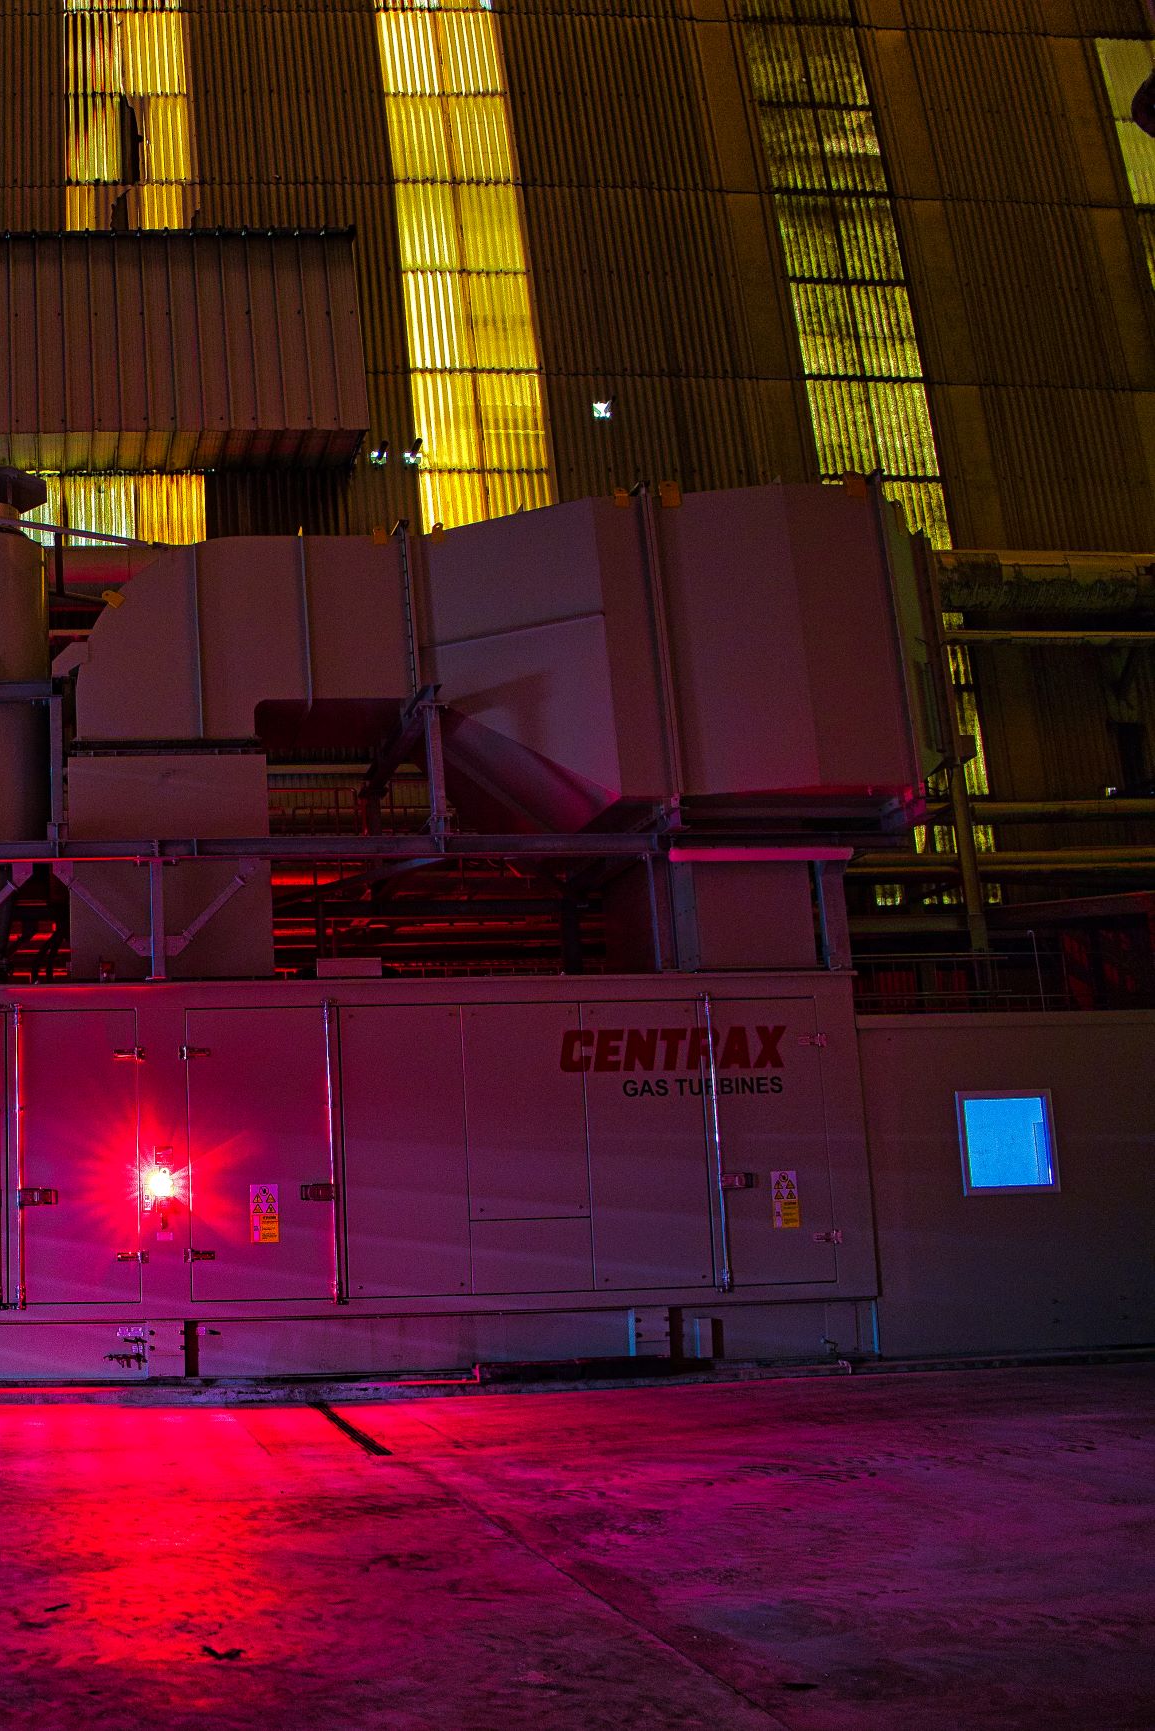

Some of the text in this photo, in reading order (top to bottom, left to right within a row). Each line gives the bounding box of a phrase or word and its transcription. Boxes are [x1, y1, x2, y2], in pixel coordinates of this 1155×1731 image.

[559, 1025, 787, 1073] CENTRAX
[622, 1076, 784, 1098] GAS TURBINES
